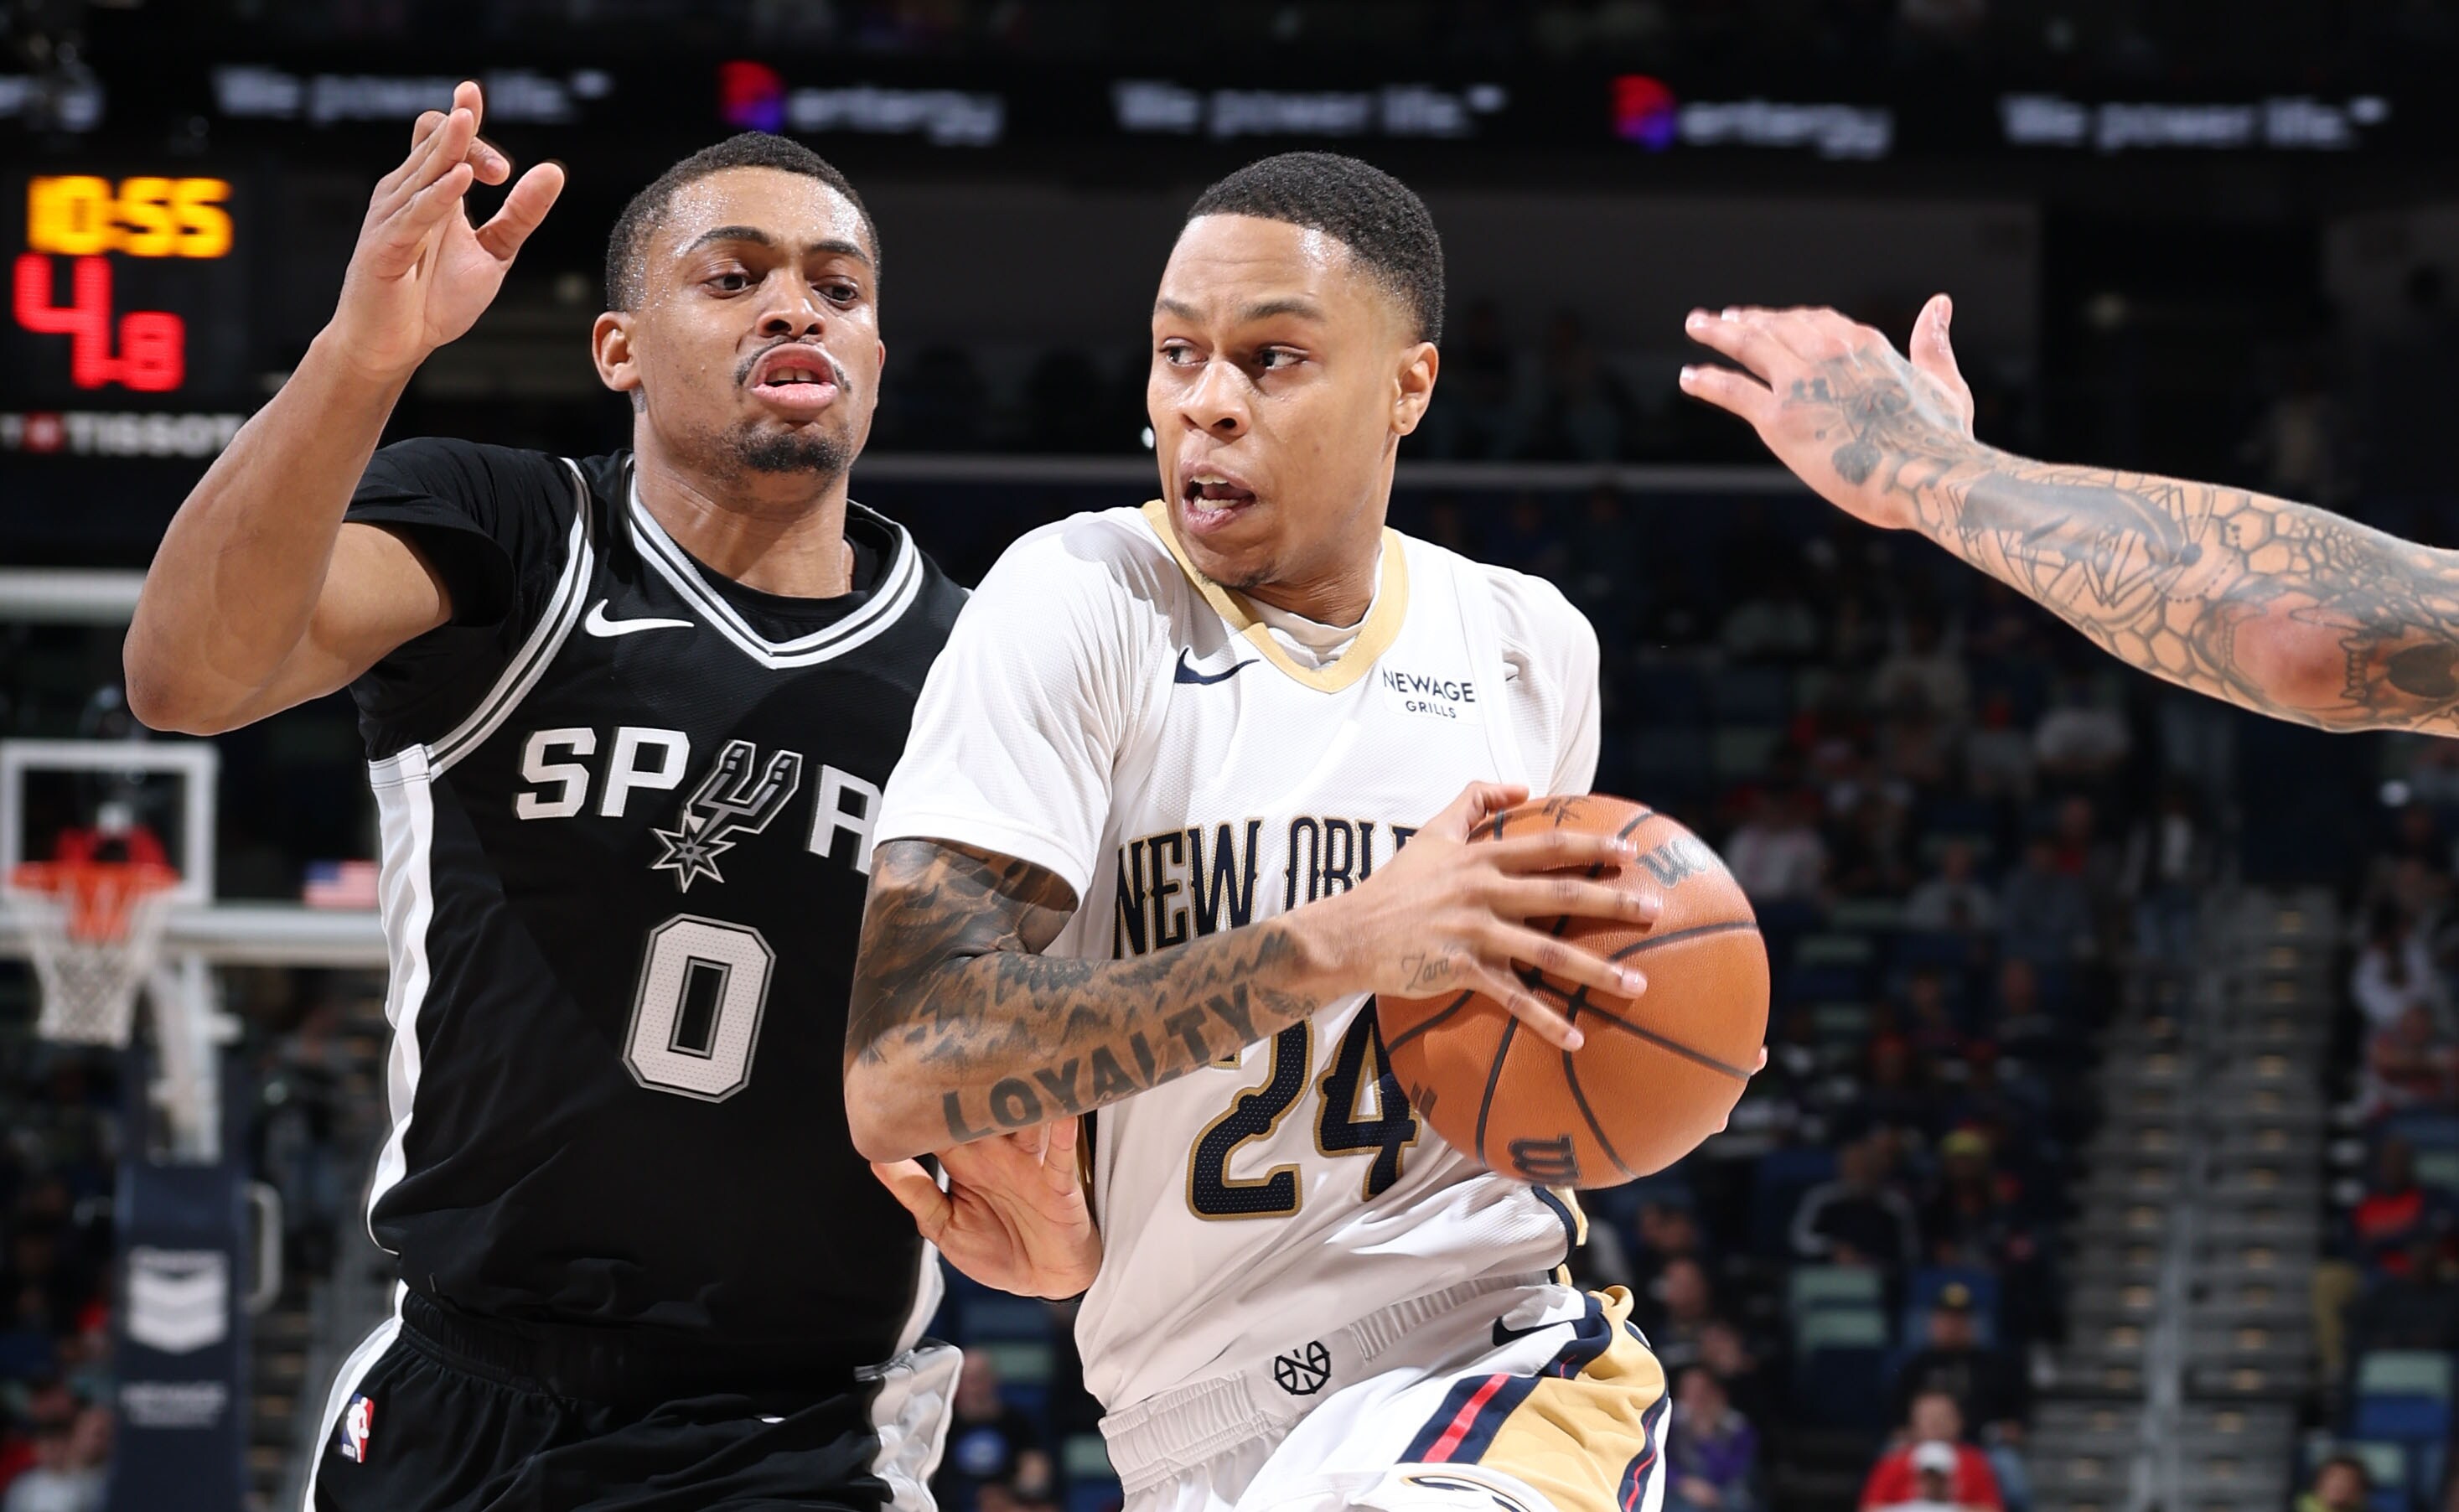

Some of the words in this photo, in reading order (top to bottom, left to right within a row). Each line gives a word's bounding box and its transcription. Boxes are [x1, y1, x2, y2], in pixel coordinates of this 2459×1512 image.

[28, 175, 233, 258] 10:55
[1381, 664, 1476, 703] NEWAGE
[1406, 701, 1457, 718] GRILLS
[1112, 816, 1264, 961] NEW
[622, 913, 776, 1103] 0
[942, 985, 1258, 1142] LOYALTY
[1186, 992, 1424, 1221] 24
